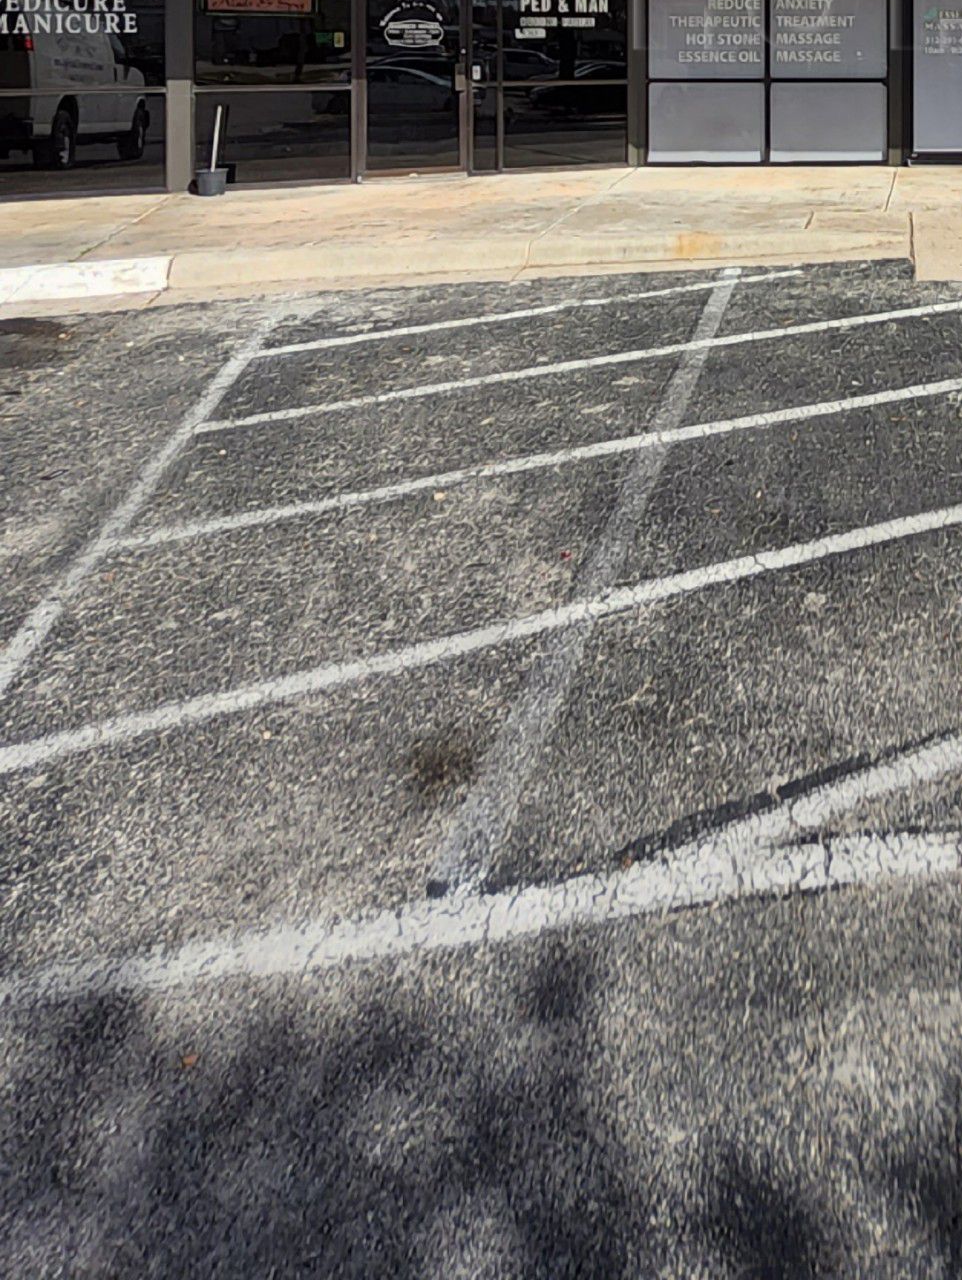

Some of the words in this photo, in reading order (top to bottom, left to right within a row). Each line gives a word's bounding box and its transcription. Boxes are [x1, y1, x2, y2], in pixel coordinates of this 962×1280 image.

[669, 15, 761, 28] THERAPEUTIC
[775, 15, 856, 28] TREATMENT
[686, 33, 714, 46] HOT
[717, 33, 761, 46] STONE
[775, 33, 841, 45] MASSAGE
[678, 50, 736, 63] ESSENCE
[738, 50, 761, 63] OIL
[775, 50, 841, 63] MASSAGE
